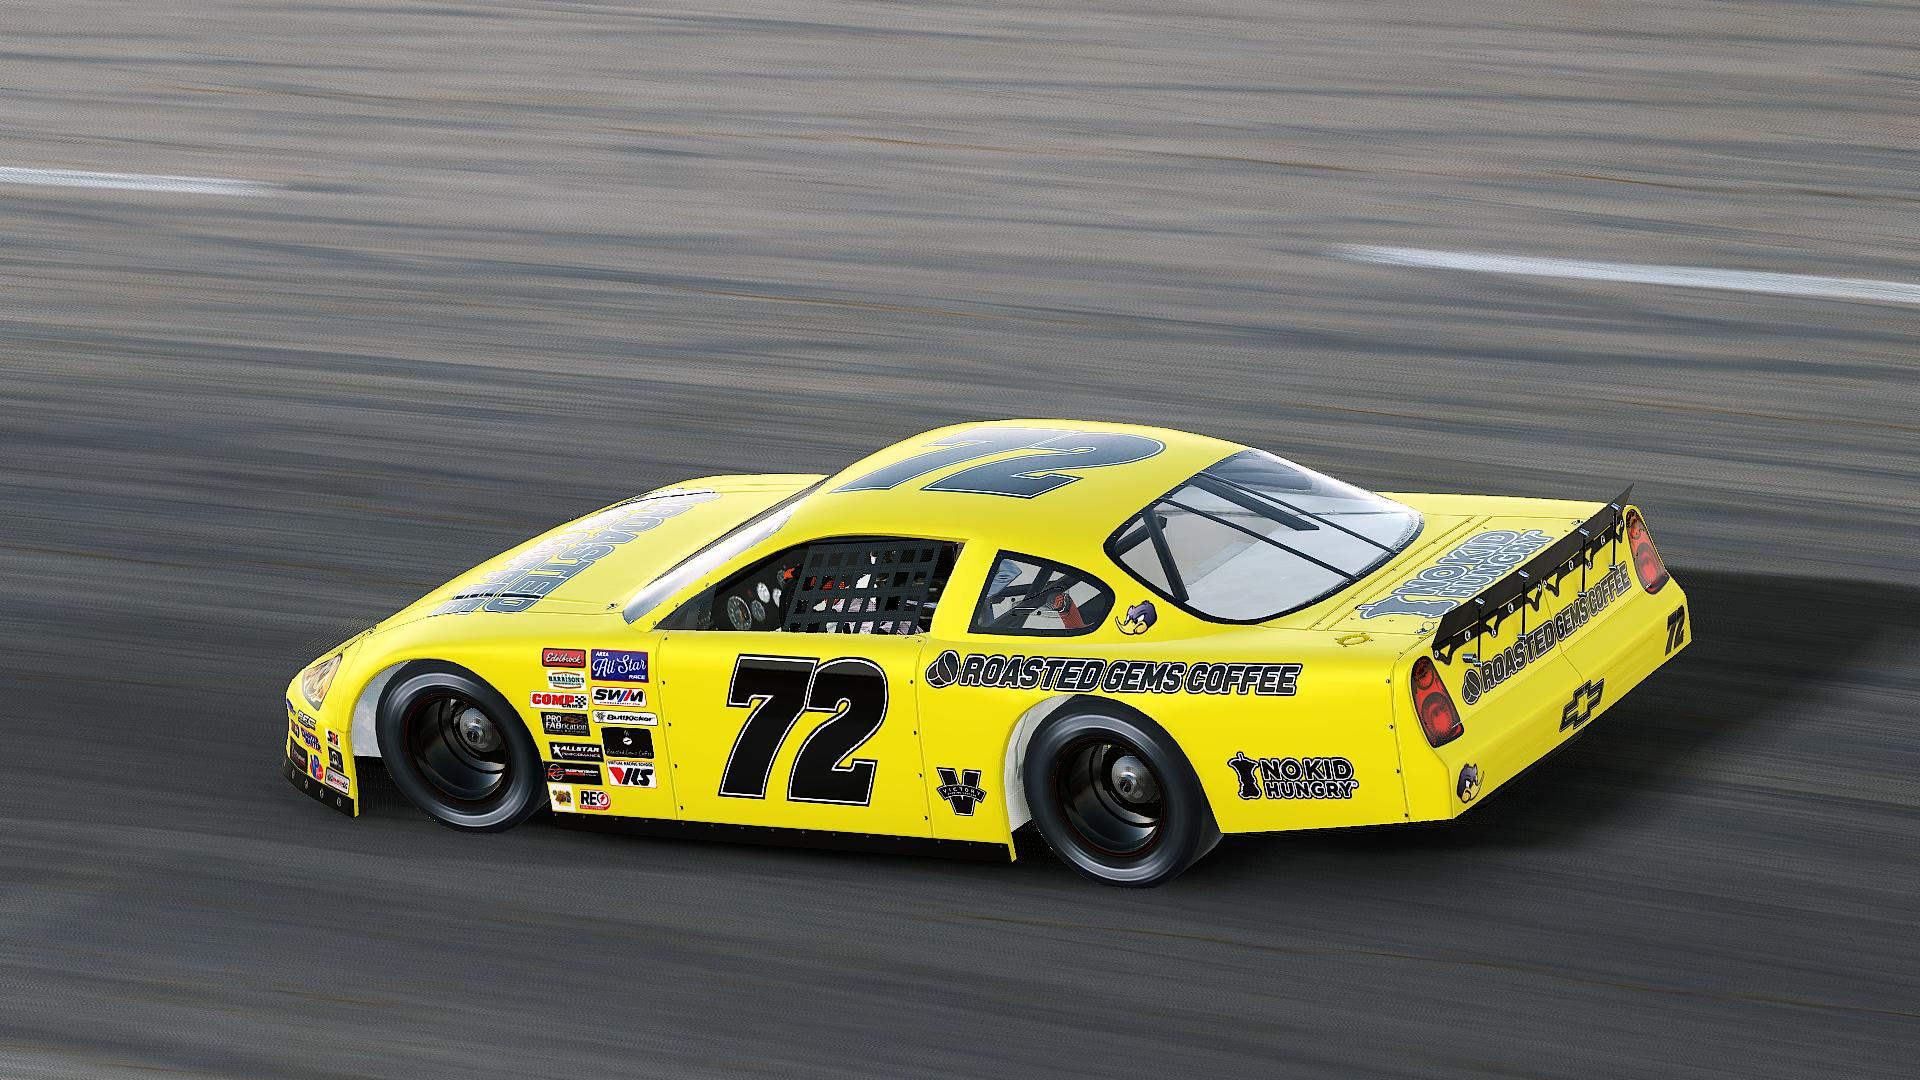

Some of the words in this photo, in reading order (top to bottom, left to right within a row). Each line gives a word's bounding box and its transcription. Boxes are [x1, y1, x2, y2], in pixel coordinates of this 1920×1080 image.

[827, 427, 1167, 499] 72
[1391, 565, 1471, 596] NO
[1436, 530, 1521, 565] KID
[1436, 530, 1555, 598] HUNGRY
[1481, 620, 1556, 693] ROASTED
[1554, 597, 1591, 642] GEMS
[1586, 561, 1632, 616] COFFEE
[1664, 604, 1686, 656] 72
[546, 652, 581, 664] Edelbrock
[592, 658, 615, 677] All
[617, 654, 646, 674] Star
[960, 653, 1106, 690] ROASTED
[1102, 660, 1185, 694] GEMS
[1184, 662, 1302, 696] COFFEE
[532, 693, 575, 705] COMP
[546, 714, 562, 722] PRO
[546, 721, 587, 731] FABrication
[718, 653, 889, 807] 72
[1259, 758, 1303, 782] NO
[1302, 757, 1354, 781] KID
[942, 786, 981, 796] VICTORY
[1263, 780, 1354, 799] HUNGRY
